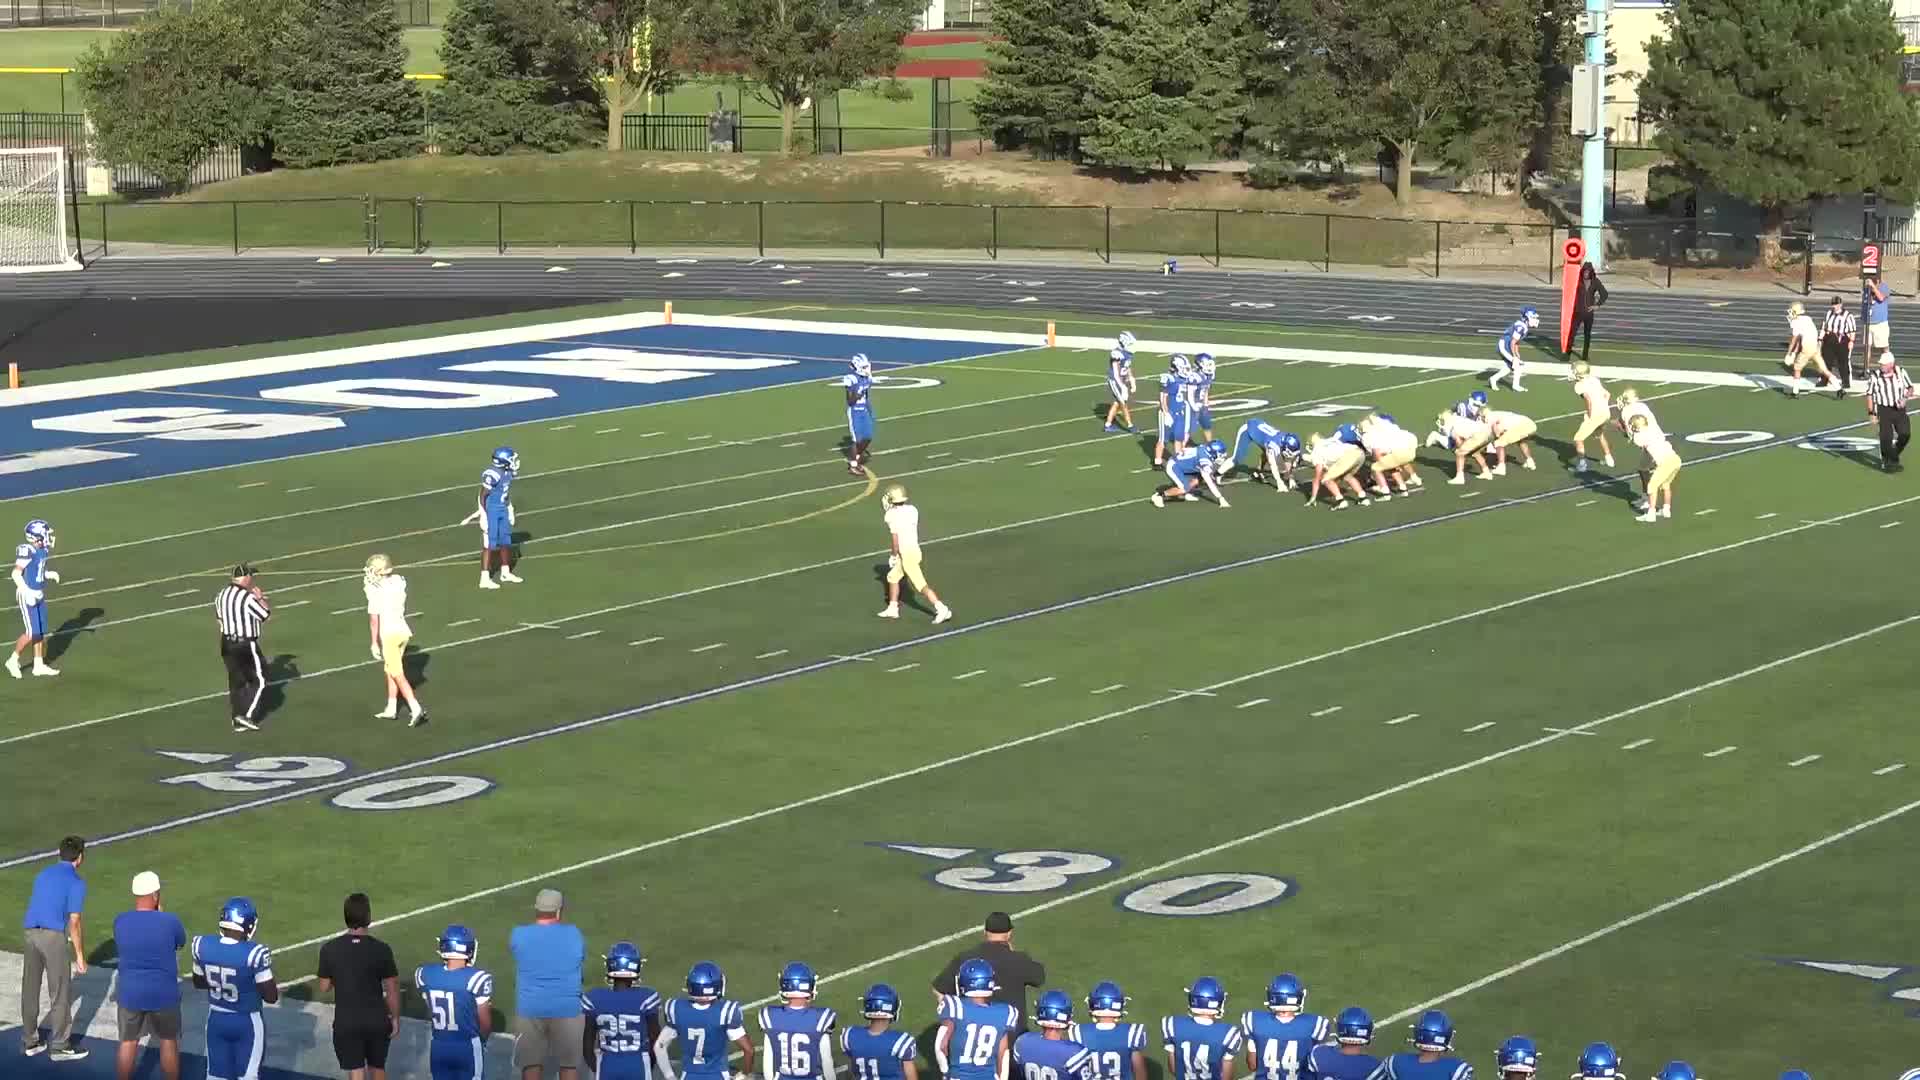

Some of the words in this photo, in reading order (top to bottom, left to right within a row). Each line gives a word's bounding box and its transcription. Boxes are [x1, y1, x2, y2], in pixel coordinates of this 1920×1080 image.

[1863, 246, 1878, 266] 2
[205, 964, 239, 1003] 55
[429, 990, 459, 1032] 51
[596, 1014, 641, 1053] 25
[688, 1028, 705, 1064] 7
[959, 1024, 998, 1066] 18
[777, 1032, 811, 1076] 16
[855, 1057, 881, 1080] 11
[1181, 1041, 1210, 1080] 14
[1263, 1039, 1300, 1080] 44
